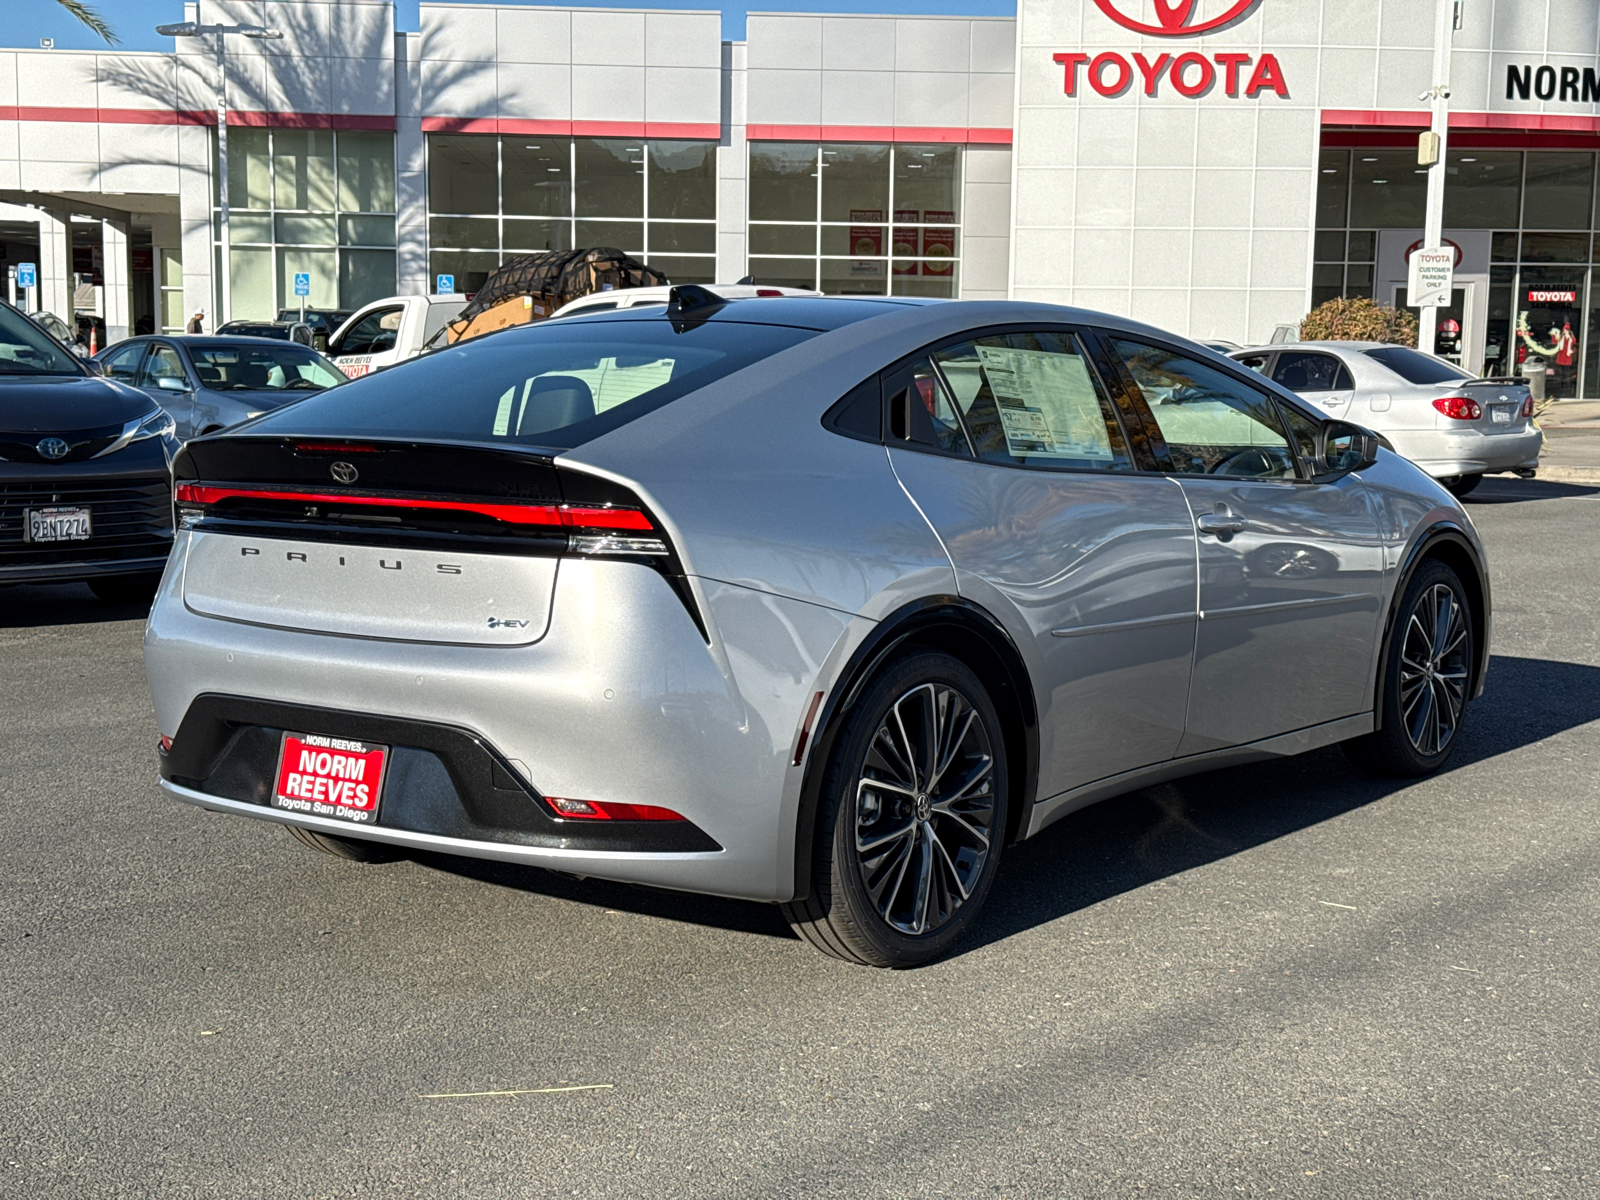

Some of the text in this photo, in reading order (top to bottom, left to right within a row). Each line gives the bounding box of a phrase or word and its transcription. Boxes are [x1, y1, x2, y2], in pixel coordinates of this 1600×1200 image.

[1053, 51, 1287, 97] TOYOTA
[1532, 292, 1572, 301] TOYOTA
[338, 366, 368, 377] TOYOTA
[33, 519, 88, 537] 9BNT274
[241, 547, 462, 575] PRIUS
[306, 735, 362, 752] NORM REEVES
[298, 750, 366, 781] NORM
[286, 772, 370, 807] REEVES
[277, 795, 369, 821] Toyota San Diego
